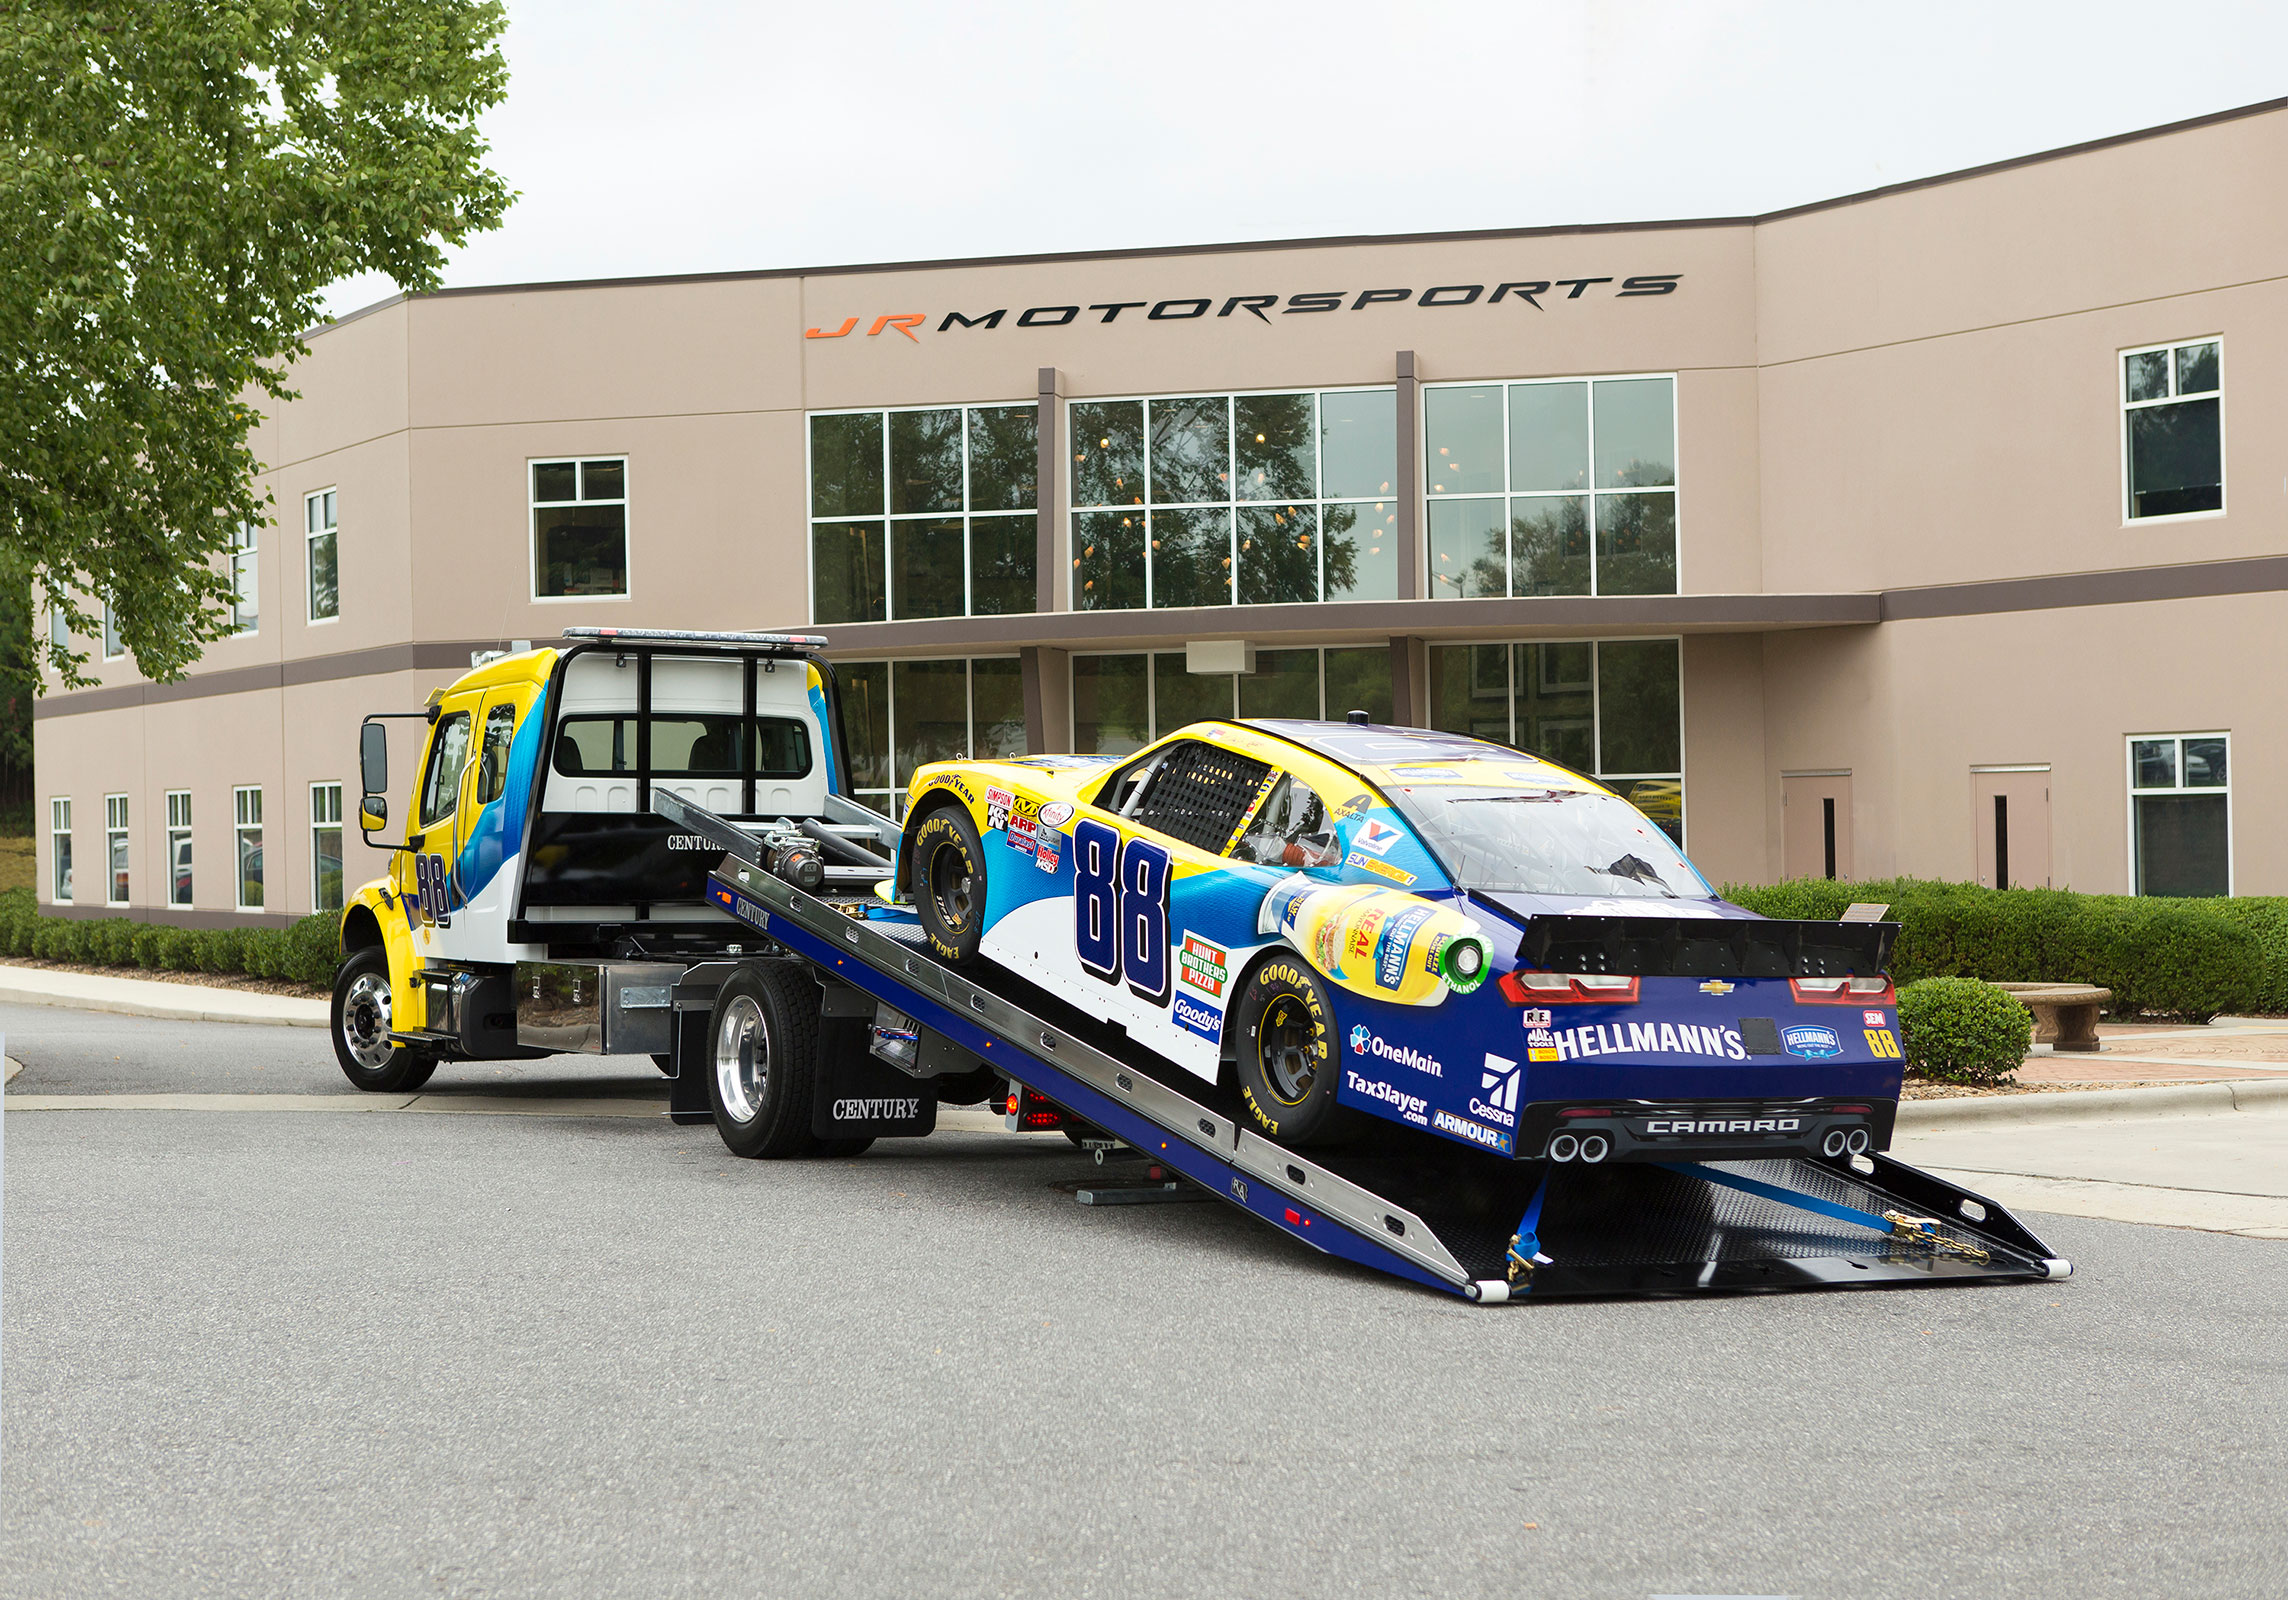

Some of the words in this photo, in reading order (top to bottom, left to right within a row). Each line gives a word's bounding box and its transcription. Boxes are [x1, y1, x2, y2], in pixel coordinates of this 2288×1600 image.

[805, 313, 928, 343] JR
[938, 274, 1684, 332] MOTORSPORTS
[928, 774, 975, 805] GOODYEAR
[987, 788, 1013, 807] SIMPSON
[1010, 815, 1037, 833] ARP
[1042, 807, 1066, 823] xfinity
[1334, 807, 1365, 823] AXALTA
[1009, 832, 1035, 849] Duralast
[1357, 837, 1383, 852] Valvoline
[1035, 859, 1057, 875] MSD
[1036, 845, 1060, 867] Holley
[415, 853, 452, 929] 88
[736, 897, 771, 931] CENTURY
[1072, 817, 1173, 1009] 88
[1348, 908, 1373, 954] MAYONNAISE
[1354, 907, 1385, 960] REAL
[929, 932, 960, 960] EAGLE
[1193, 942, 1218, 962] HUNT
[1383, 908, 1430, 985] HELLMANN'S
[1181, 953, 1226, 981] BROTHERS
[1188, 969, 1214, 991] PIZZA
[1442, 972, 1481, 994] ETHANOL
[1174, 999, 1221, 1031] Goody's
[1259, 964, 1328, 1060] GOODYEAR
[1527, 1028, 1554, 1041] MAC
[1553, 1022, 1747, 1062] HELLMANN'S
[1786, 1031, 1836, 1046] HELLMANN'S
[1863, 1029, 1901, 1058] 88
[1371, 1036, 1439, 1077] OneMain
[1347, 1070, 1428, 1113] TaxSlayer
[832, 1098, 919, 1120] CENTURY
[1242, 1085, 1279, 1136] EAGLE
[1402, 1110, 1428, 1126] .com
[1469, 1097, 1514, 1127] Cessna
[1434, 1112, 1498, 1147] ARMOUR
[1646, 1118, 1800, 1133] CAMARO
